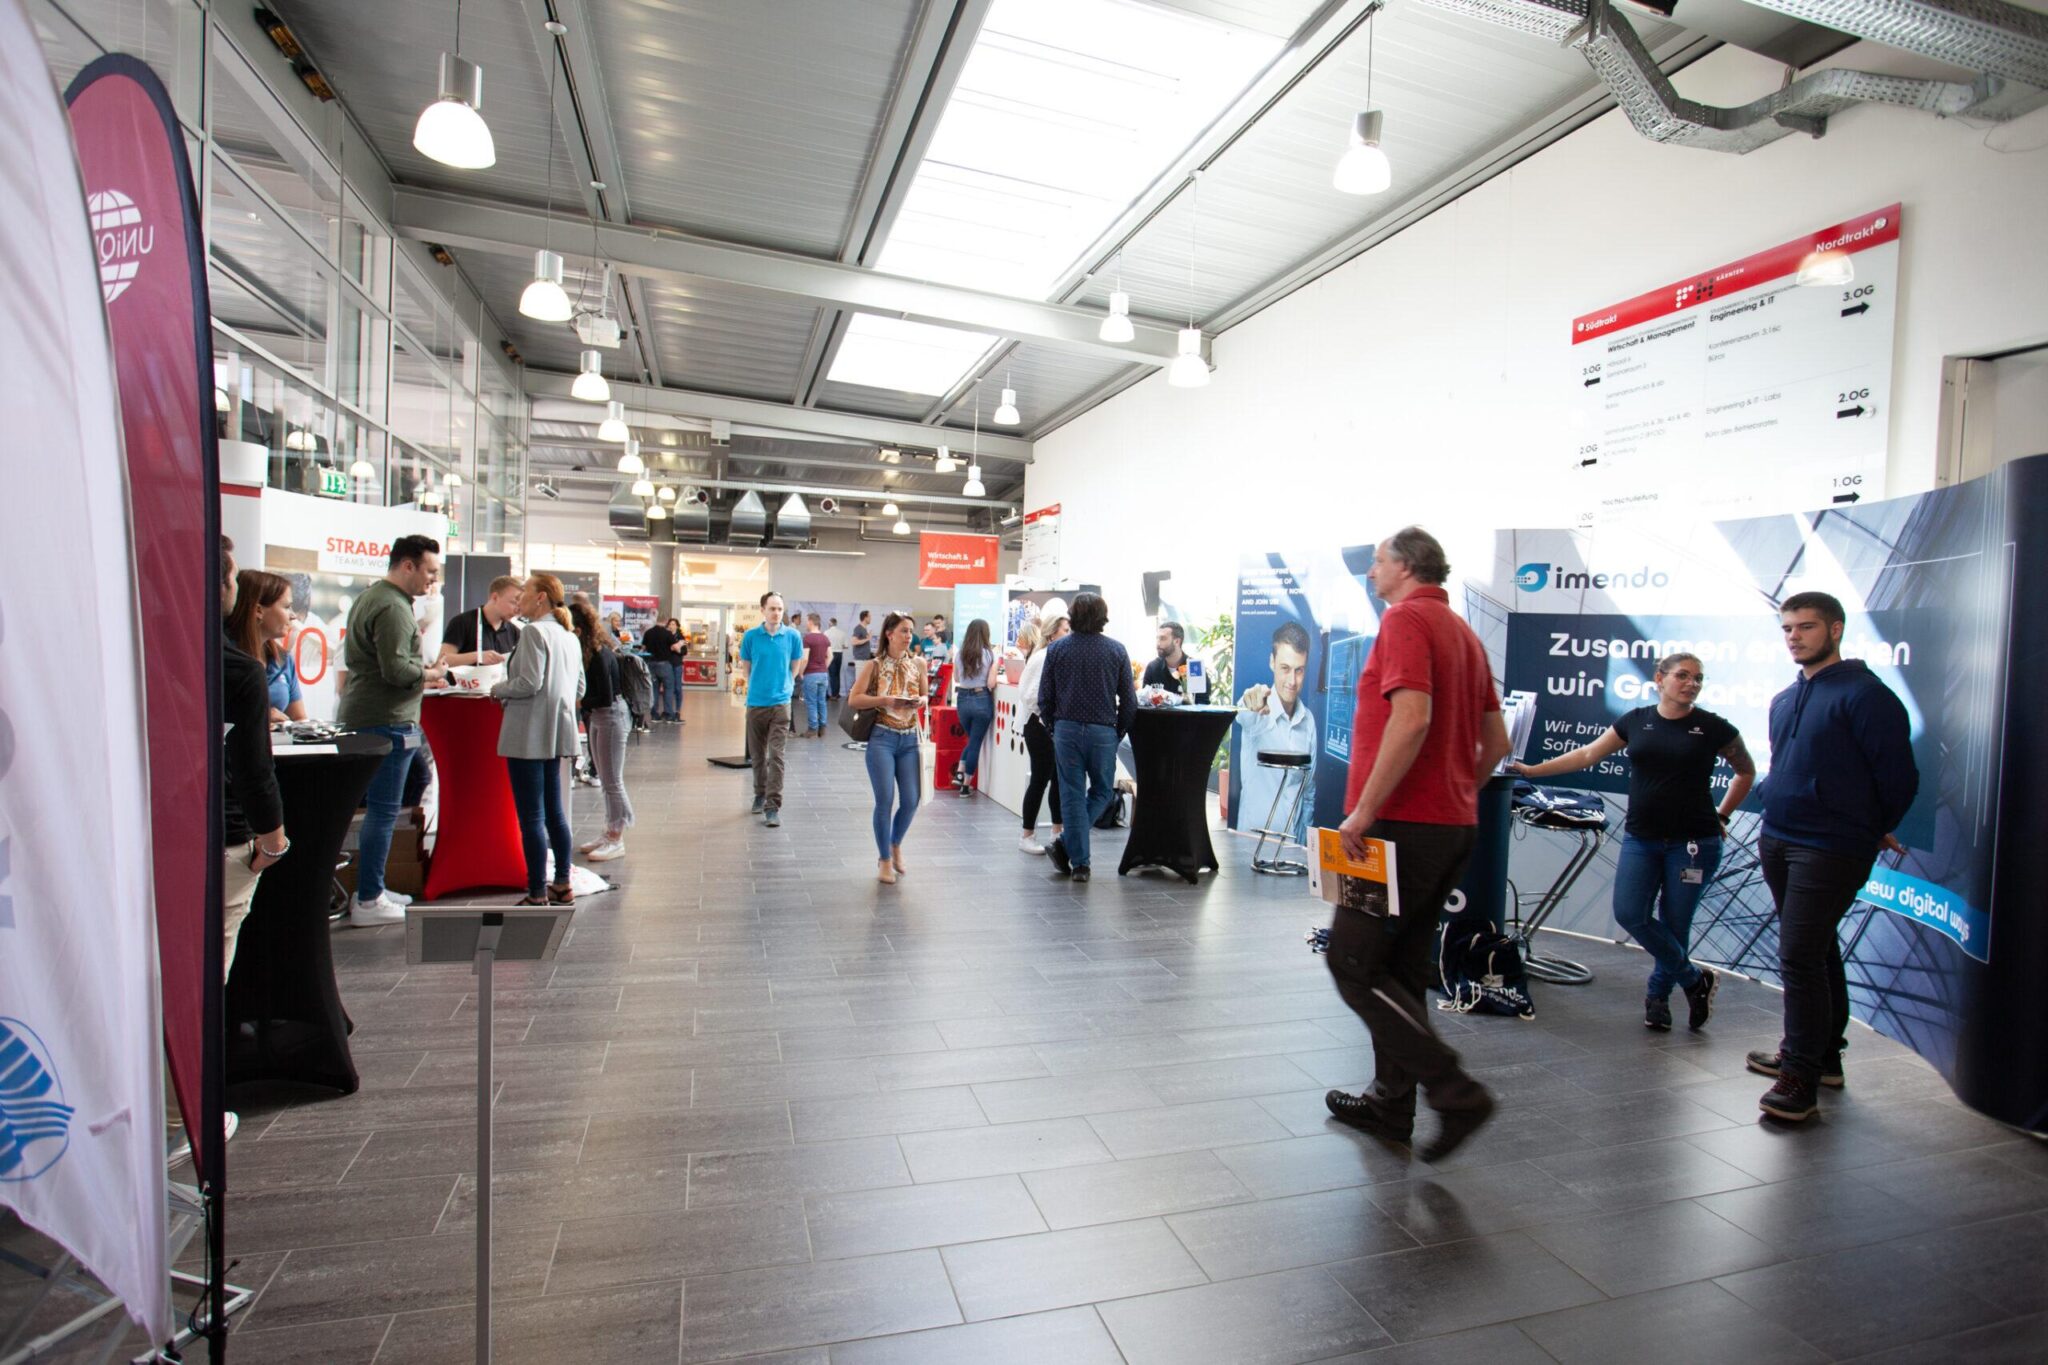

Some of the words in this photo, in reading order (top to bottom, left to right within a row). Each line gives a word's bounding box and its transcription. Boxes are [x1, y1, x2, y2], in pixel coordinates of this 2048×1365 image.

[1815, 226, 1874, 253] Nordtrakt
[1842, 285, 1875, 302] 3.OG
[1710, 302, 1757, 323] Engineering
[1759, 299, 1765, 308] &
[1767, 295, 1775, 305] IT
[1585, 314, 1617, 332] Südtrakt
[1607, 337, 1639, 353] Wirtschaft
[1640, 336, 1645, 344] &
[1646, 320, 1696, 342] Management
[1838, 388, 1869, 403] 2.OG
[1832, 475, 1863, 488] 1.OG
[326, 537, 392, 557] STRABA
[927, 551, 962, 561] Wirtschaft
[963, 553, 968, 561] &
[927, 561, 971, 570] Management
[1555, 565, 1669, 589] imendo
[1549, 633, 1737, 662] Zusammen
[1746, 632, 1910, 667] erchen
[1547, 671, 1605, 697] wir
[1544, 719, 1572, 733] Wir
[1598, 760, 1625, 776] Sie
[1898, 885, 1949, 923] digital
[1949, 909, 1971, 943] ways
